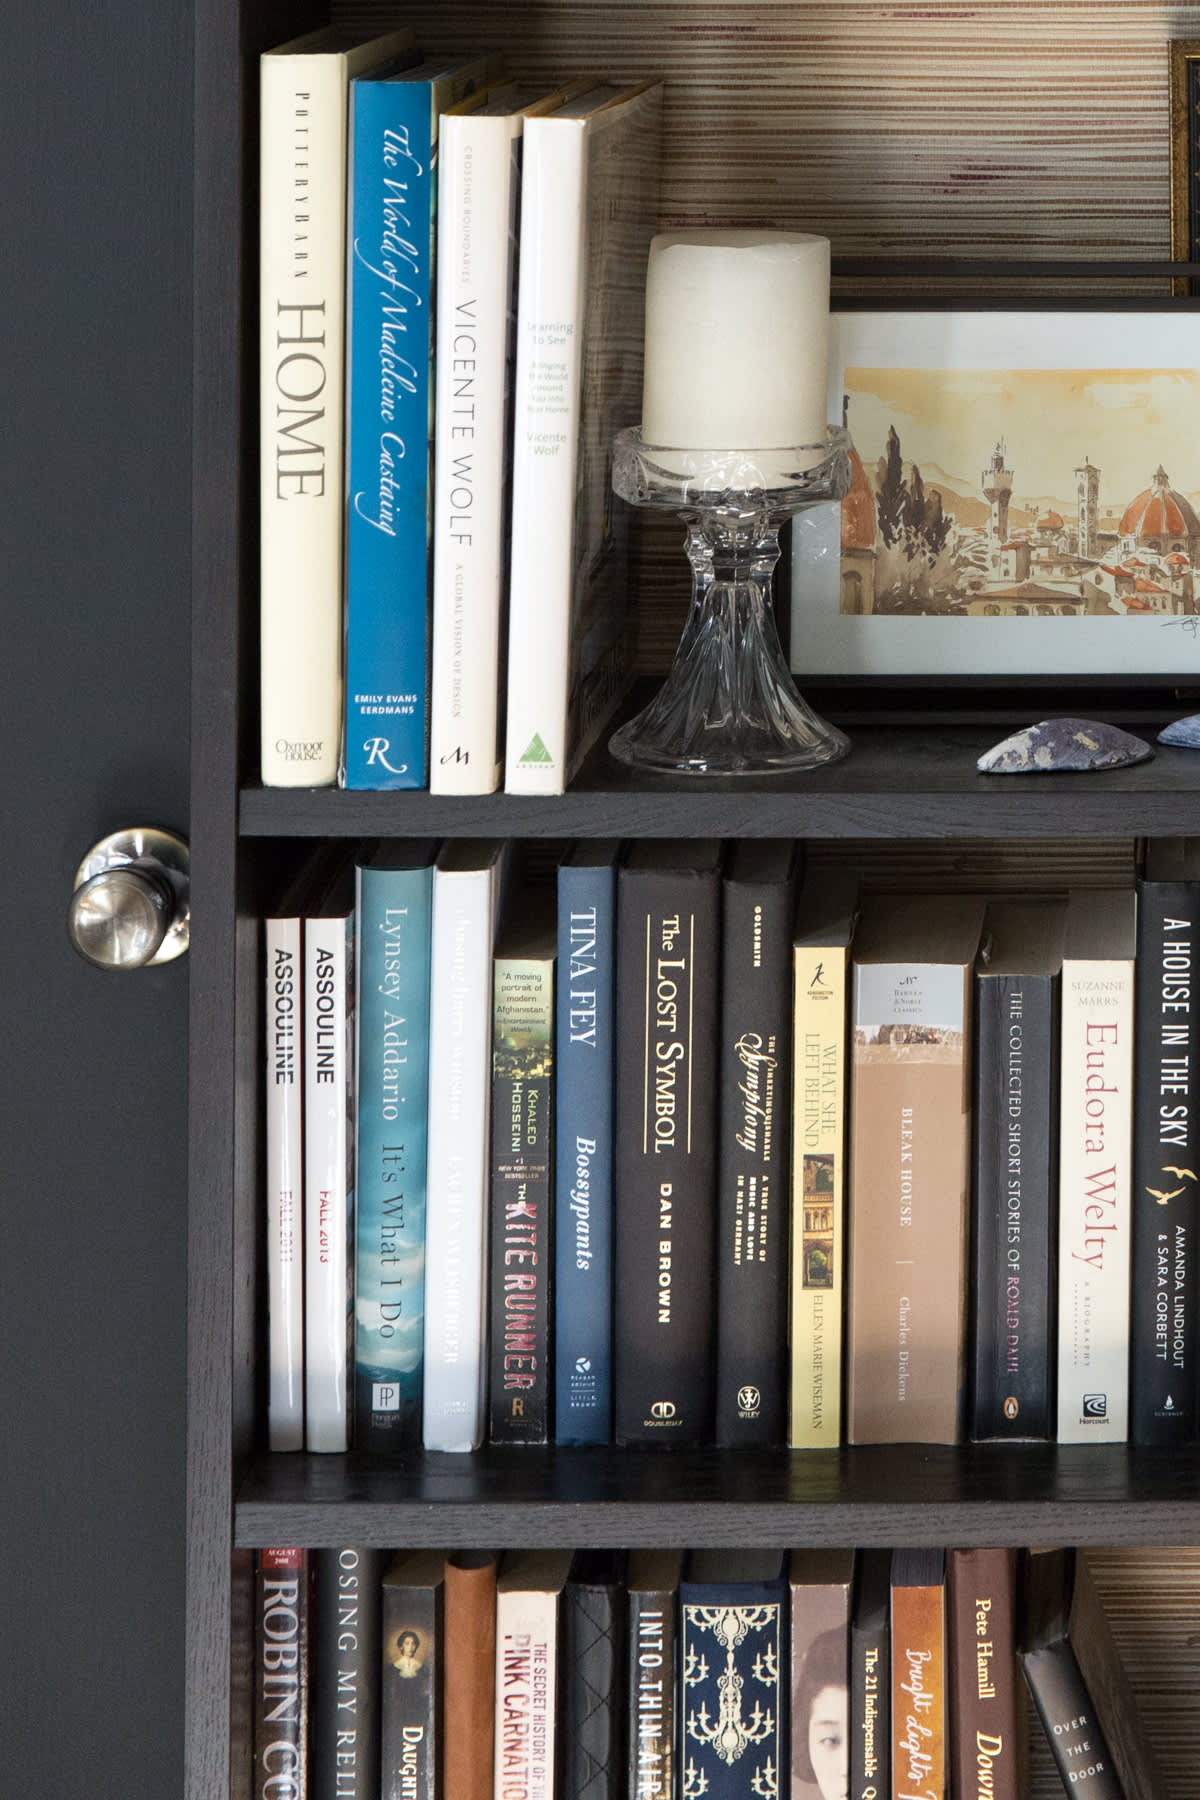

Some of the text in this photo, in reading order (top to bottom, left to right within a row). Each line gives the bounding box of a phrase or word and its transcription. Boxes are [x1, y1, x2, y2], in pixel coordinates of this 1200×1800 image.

[294, 93, 310, 279] POTTERY BARN
[382, 124, 423, 177] The
[379, 178, 420, 266] World
[276, 298, 327, 501] HOME
[378, 291, 418, 424] Madeleine
[449, 299, 478, 547] VICENTE WOLF
[354, 431, 406, 537] Castaing
[355, 694, 418, 703] EMILY EVANS
[361, 706, 414, 715] EERDMANS
[569, 907, 597, 1048] TINA FEY
[753, 906, 762, 967] GOLDSMITH
[275, 948, 294, 1085] ASSOULINE
[316, 947, 335, 1084] ASSOULINE
[378, 907, 408, 1121] Lynsey Addario
[655, 914, 686, 1154] The LOST SYMBOL
[1159, 917, 1192, 1147] A HOUSE IN THE SKY
[511, 1082, 522, 1152] HOSSEINI
[527, 1089, 539, 1145] KHALED
[899, 1107, 913, 1227] BLEAK HOUSE
[1006, 991, 1023, 1373] THE COLLECTED SHORT STORIES OF ROALD DAHL
[1072, 1020, 1119, 1270] Eudora Welty
[570, 1136, 596, 1271] Bossypants
[658, 1183, 673, 1324] DAN BROWN
[503, 1202, 538, 1390] KITE RUNNER
[263, 1578, 299, 1724] ROBIN
[638, 1611, 663, 1794] INTO THIN AIR
[862, 1648, 878, 1778] The 21 Indispensable
[975, 1598, 995, 1699] Pete Hamill
[899, 1648, 934, 1786] Bright Lights
[1053, 1716, 1088, 1735] OVER
[1067, 1741, 1091, 1756] THE
[1068, 1762, 1105, 1782] DOOR
